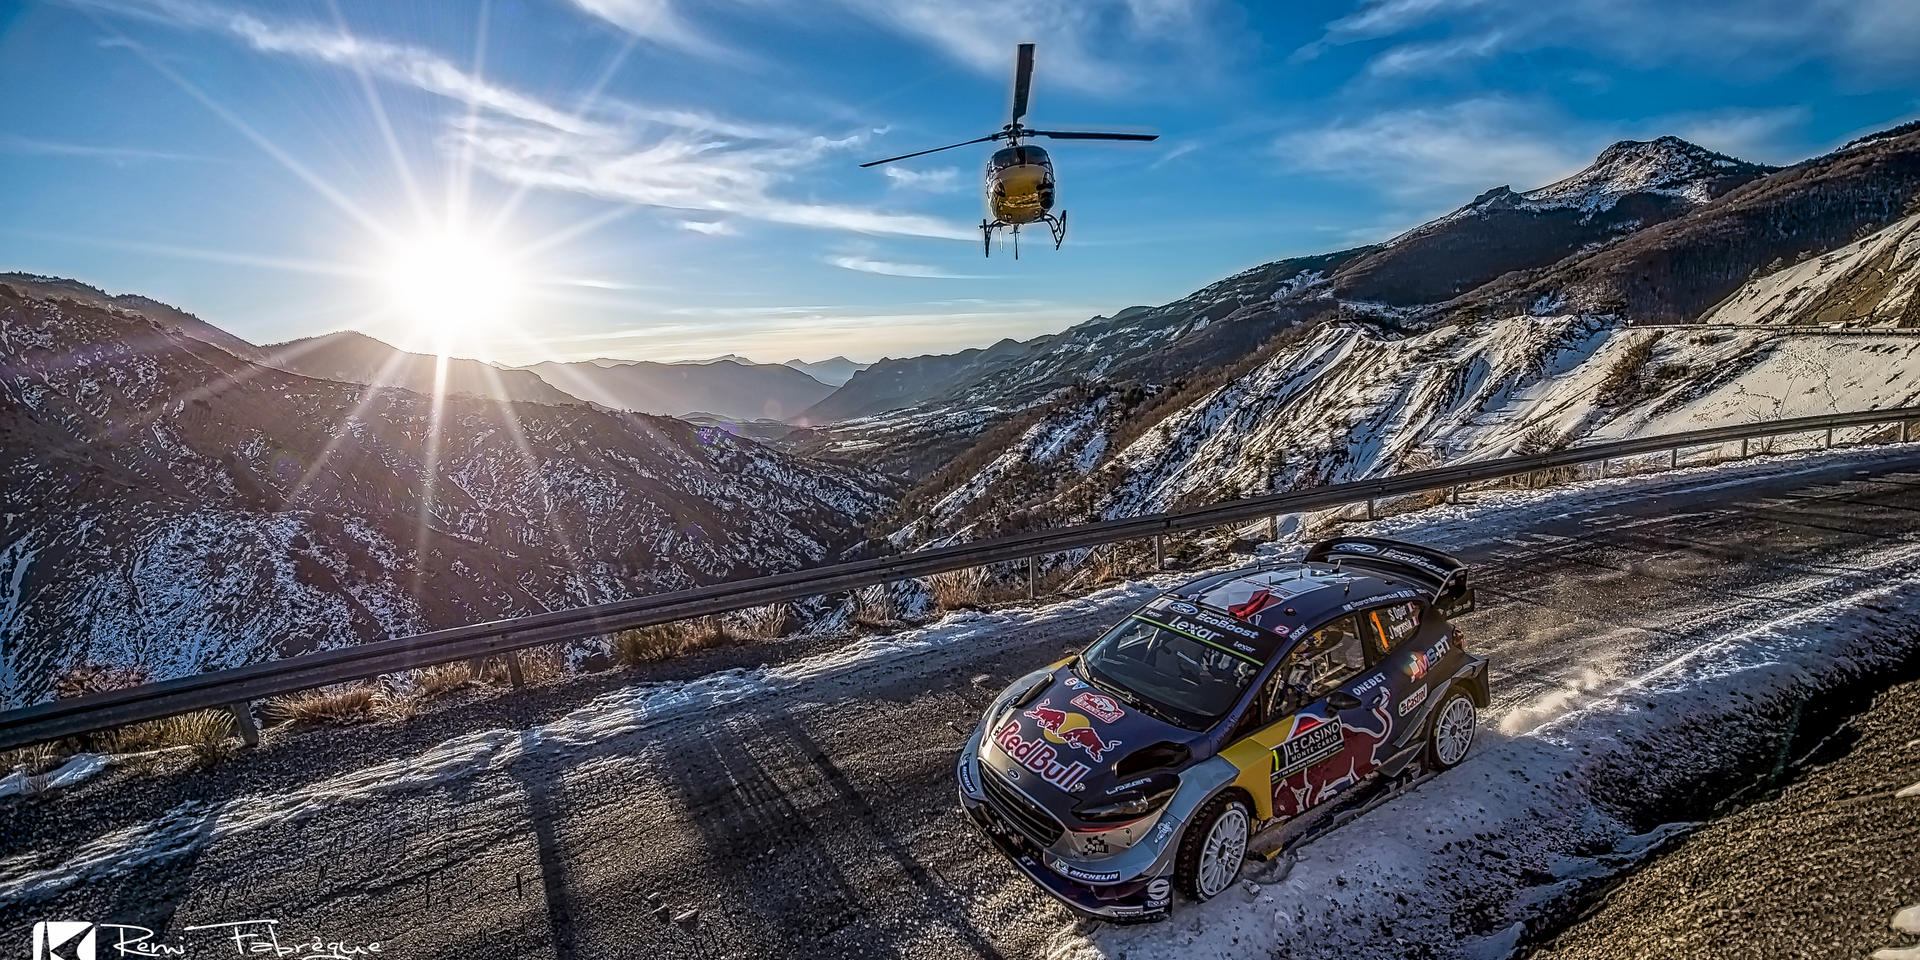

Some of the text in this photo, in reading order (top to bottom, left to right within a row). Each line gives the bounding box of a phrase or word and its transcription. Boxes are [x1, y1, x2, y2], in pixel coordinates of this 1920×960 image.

[1168, 616, 1224, 641] Lexar
[1195, 613, 1260, 640] EcoBoost
[1233, 640, 1256, 652] Lexar
[1352, 672, 1387, 696] ONEBET
[1405, 689, 1426, 711] Castrol
[1287, 722, 1339, 756] LE CASINO
[996, 720, 1091, 792] Red Bull
[1069, 869, 1119, 880] MICHELIN
